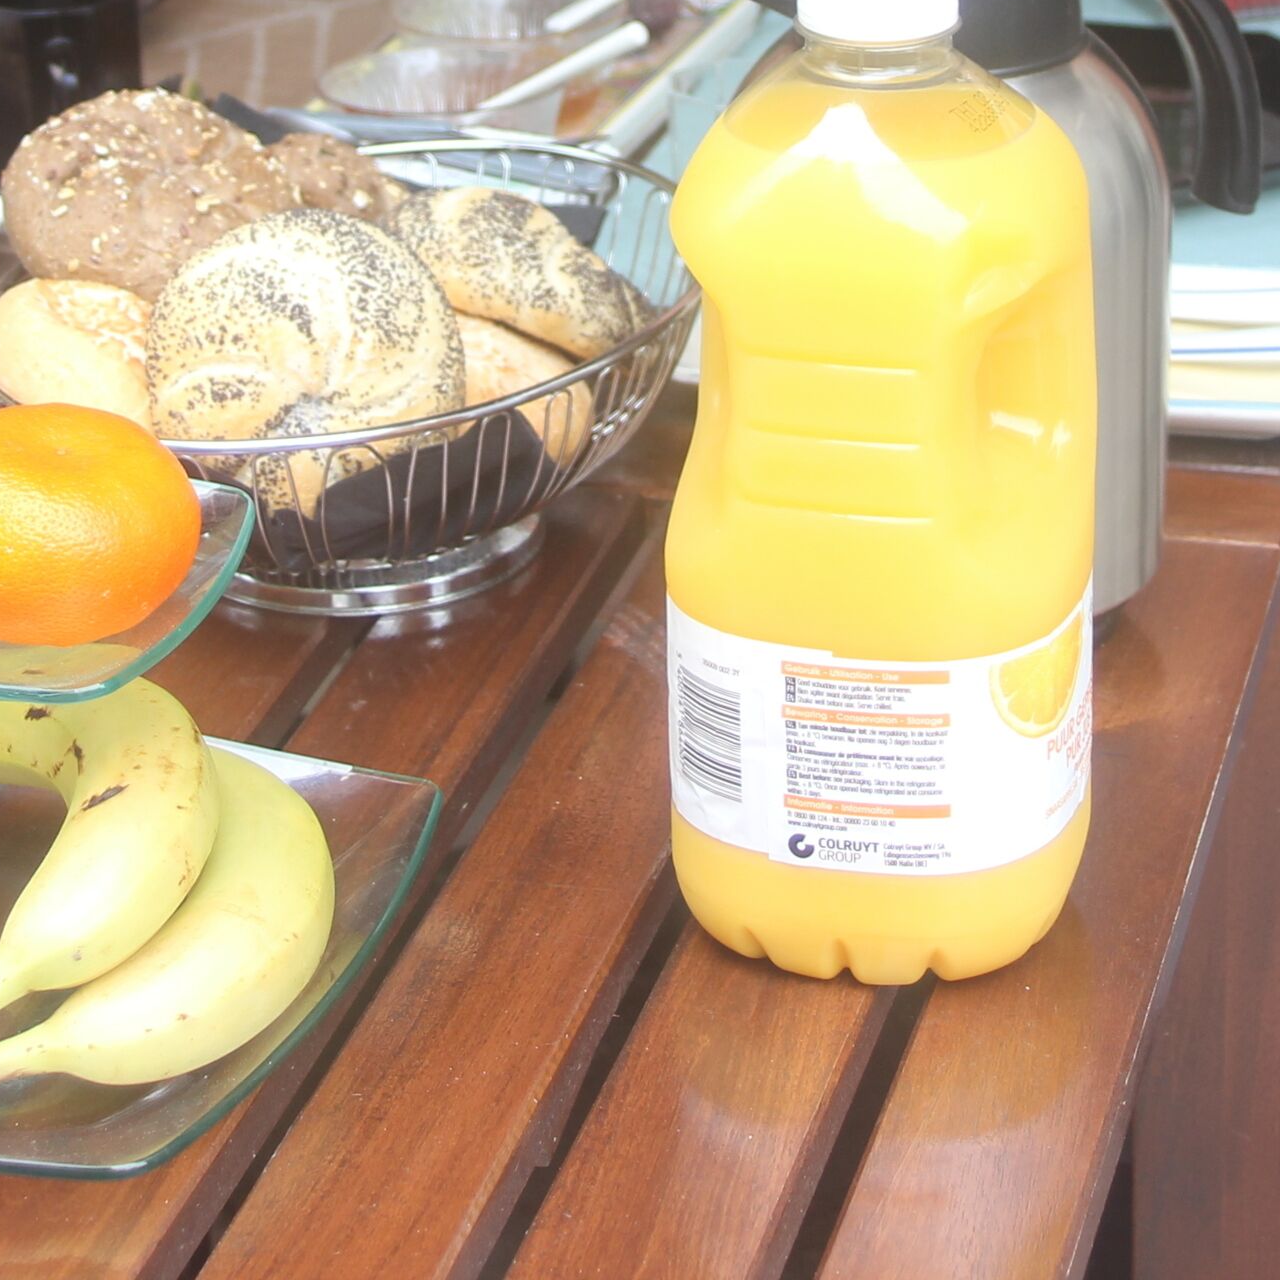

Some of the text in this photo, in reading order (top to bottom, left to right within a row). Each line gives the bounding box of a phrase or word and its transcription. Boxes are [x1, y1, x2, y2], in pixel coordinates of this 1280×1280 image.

[1047, 718, 1074, 760] PUUR
[818, 837, 879, 853] COLRUYT
[818, 849, 862, 863] GROUP
